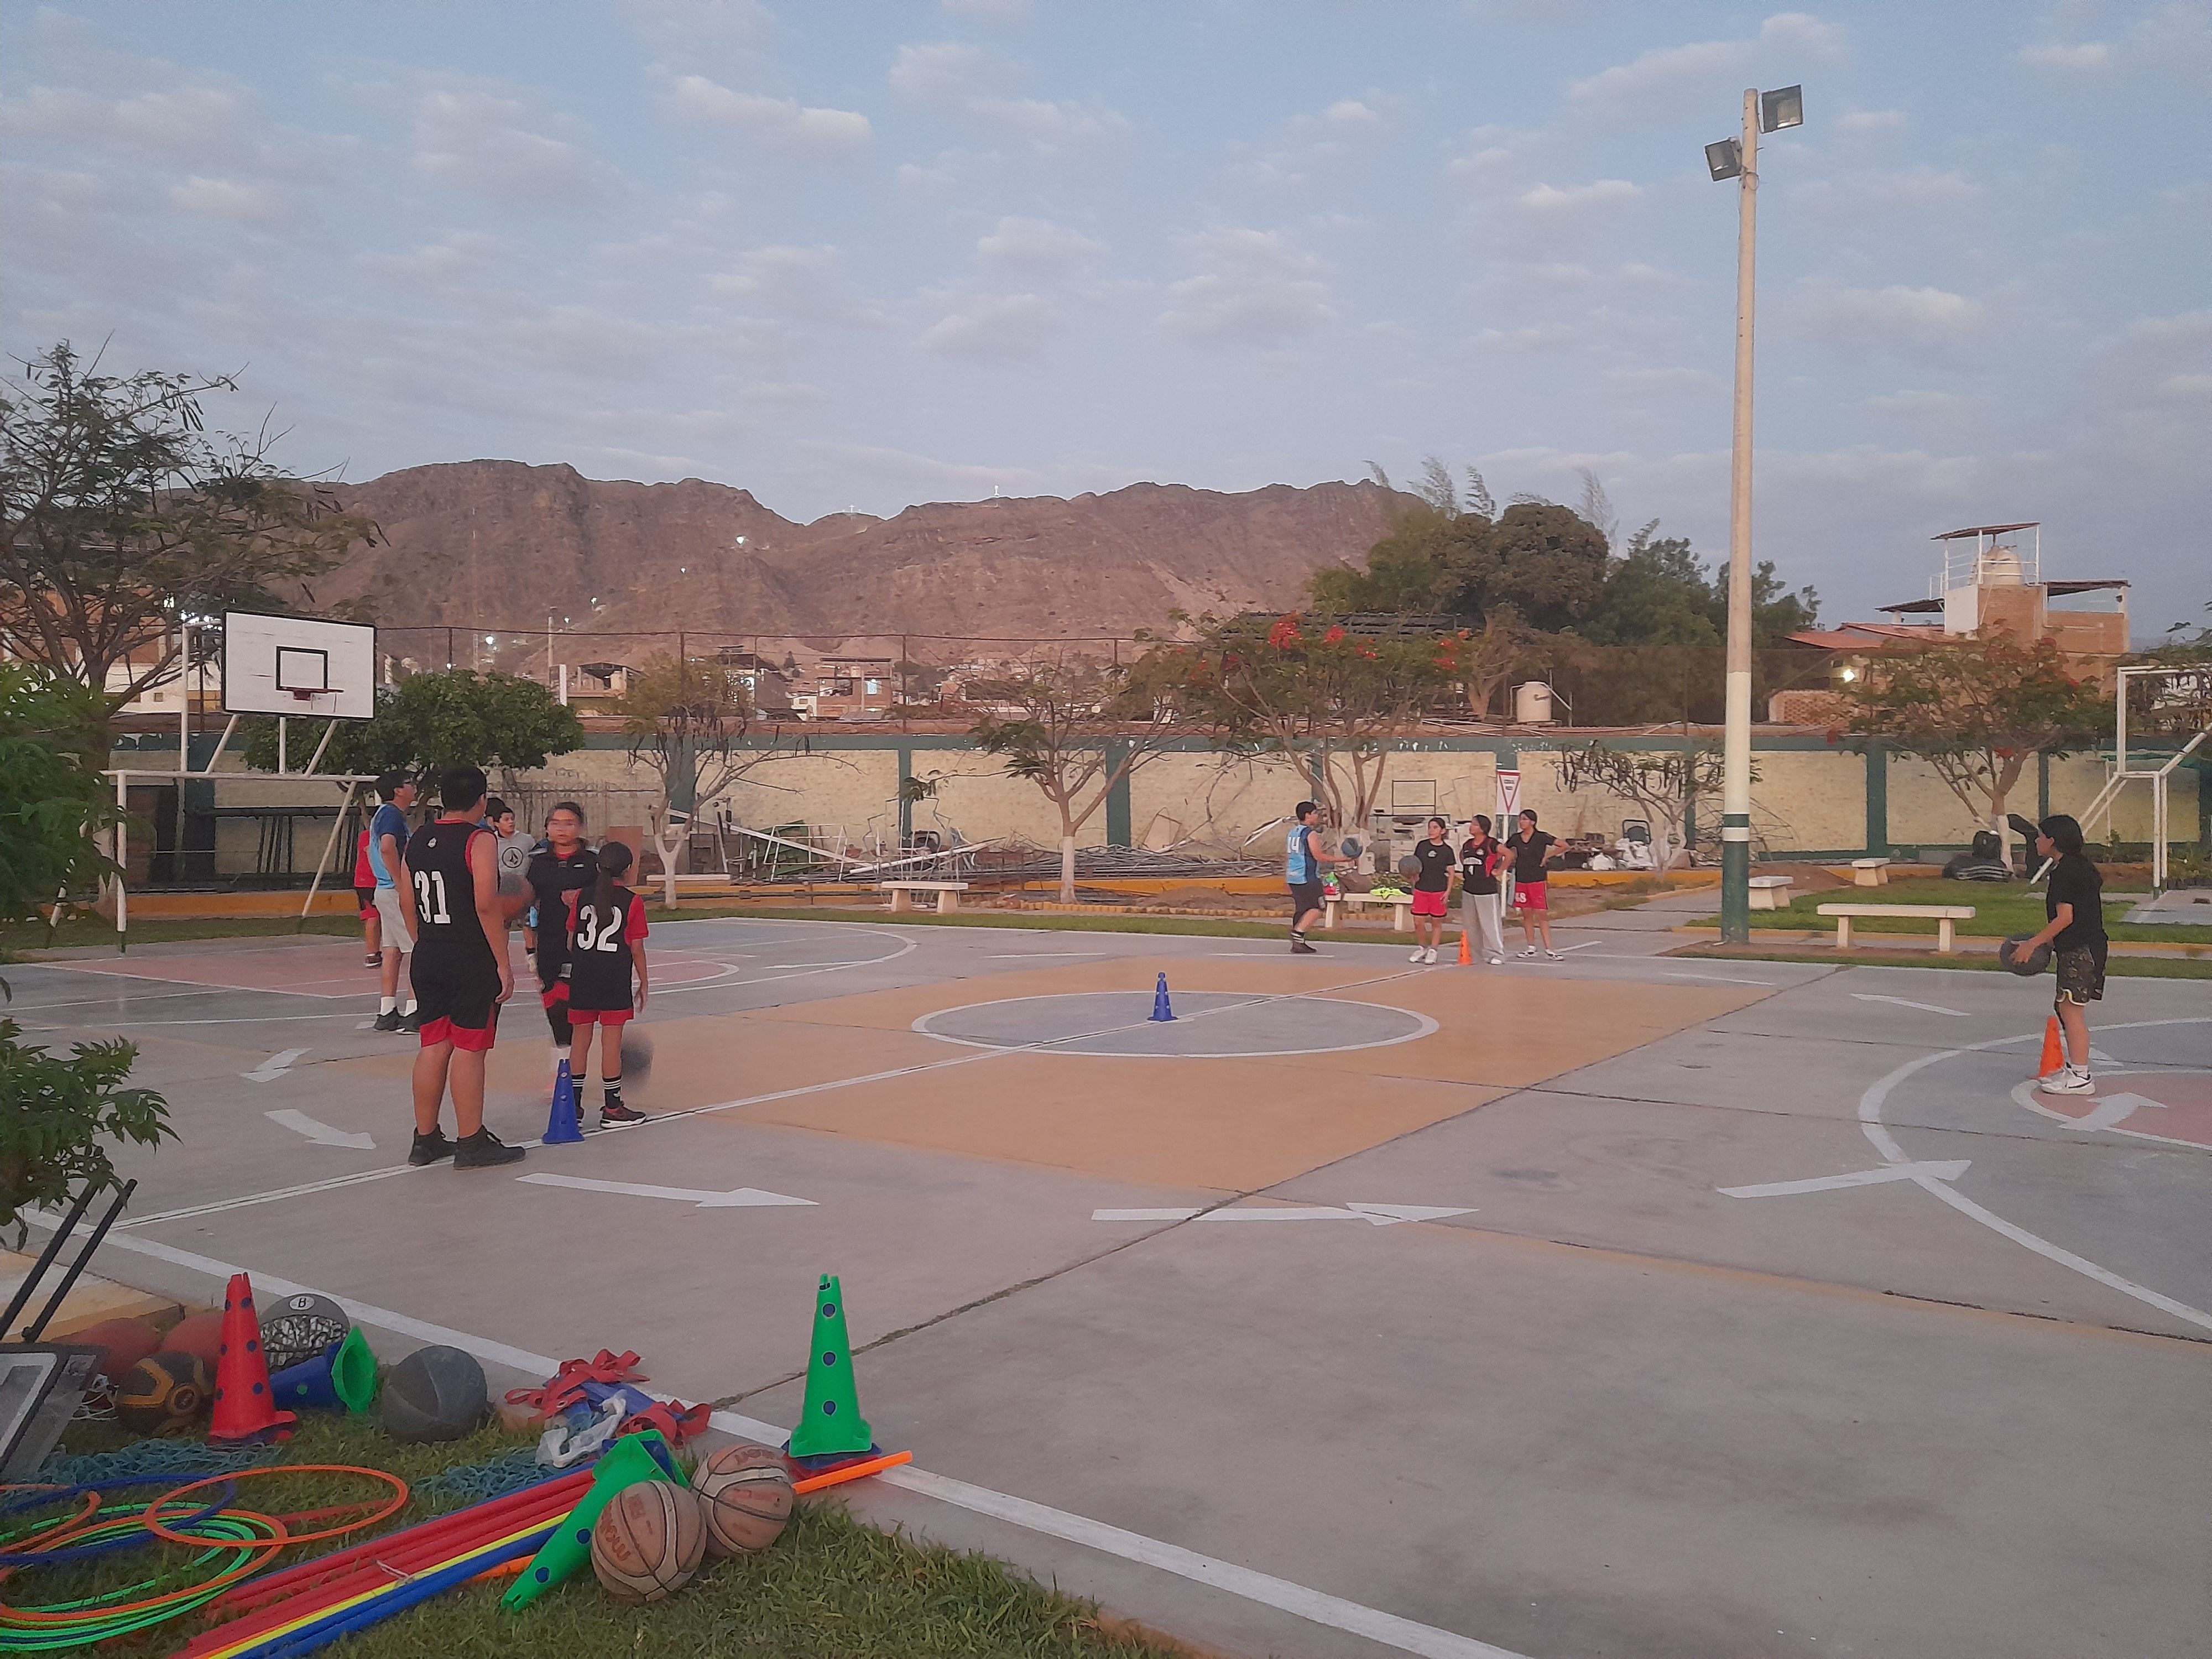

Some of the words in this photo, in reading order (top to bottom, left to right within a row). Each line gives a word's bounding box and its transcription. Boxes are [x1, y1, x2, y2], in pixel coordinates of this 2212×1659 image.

[1288, 836, 1301, 853] 14
[415, 870, 451, 924] 31
[577, 904, 622, 952] 32
